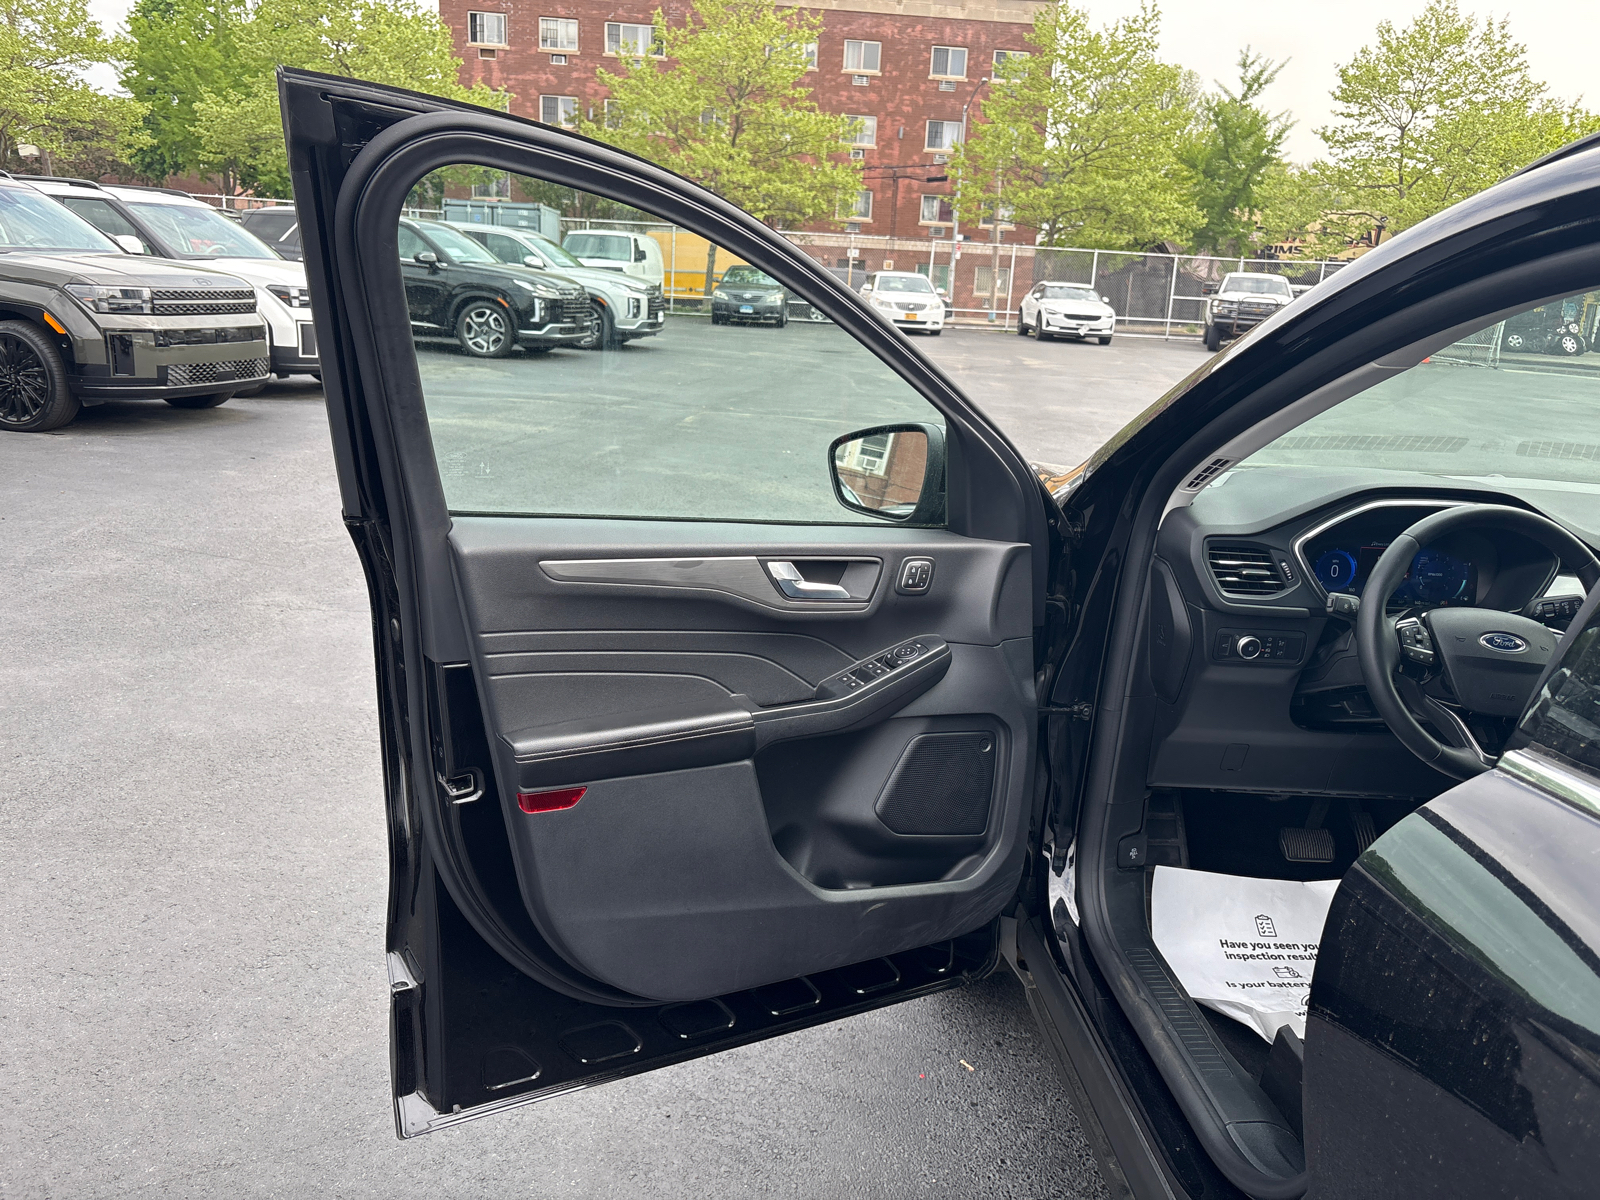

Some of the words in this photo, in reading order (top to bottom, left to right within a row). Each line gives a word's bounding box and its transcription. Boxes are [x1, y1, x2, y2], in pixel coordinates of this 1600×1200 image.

[1331, 564, 1339, 577] 0
[1492, 636, 1515, 648] Ford
[1219, 939, 1248, 949] Have
[1249, 941, 1272, 951] you
[1273, 942, 1300, 950] seen
[1301, 943, 1320, 952] you
[1224, 951, 1286, 961] inspection
[1287, 952, 1318, 961] result
[1266, 980, 1312, 989] battery
